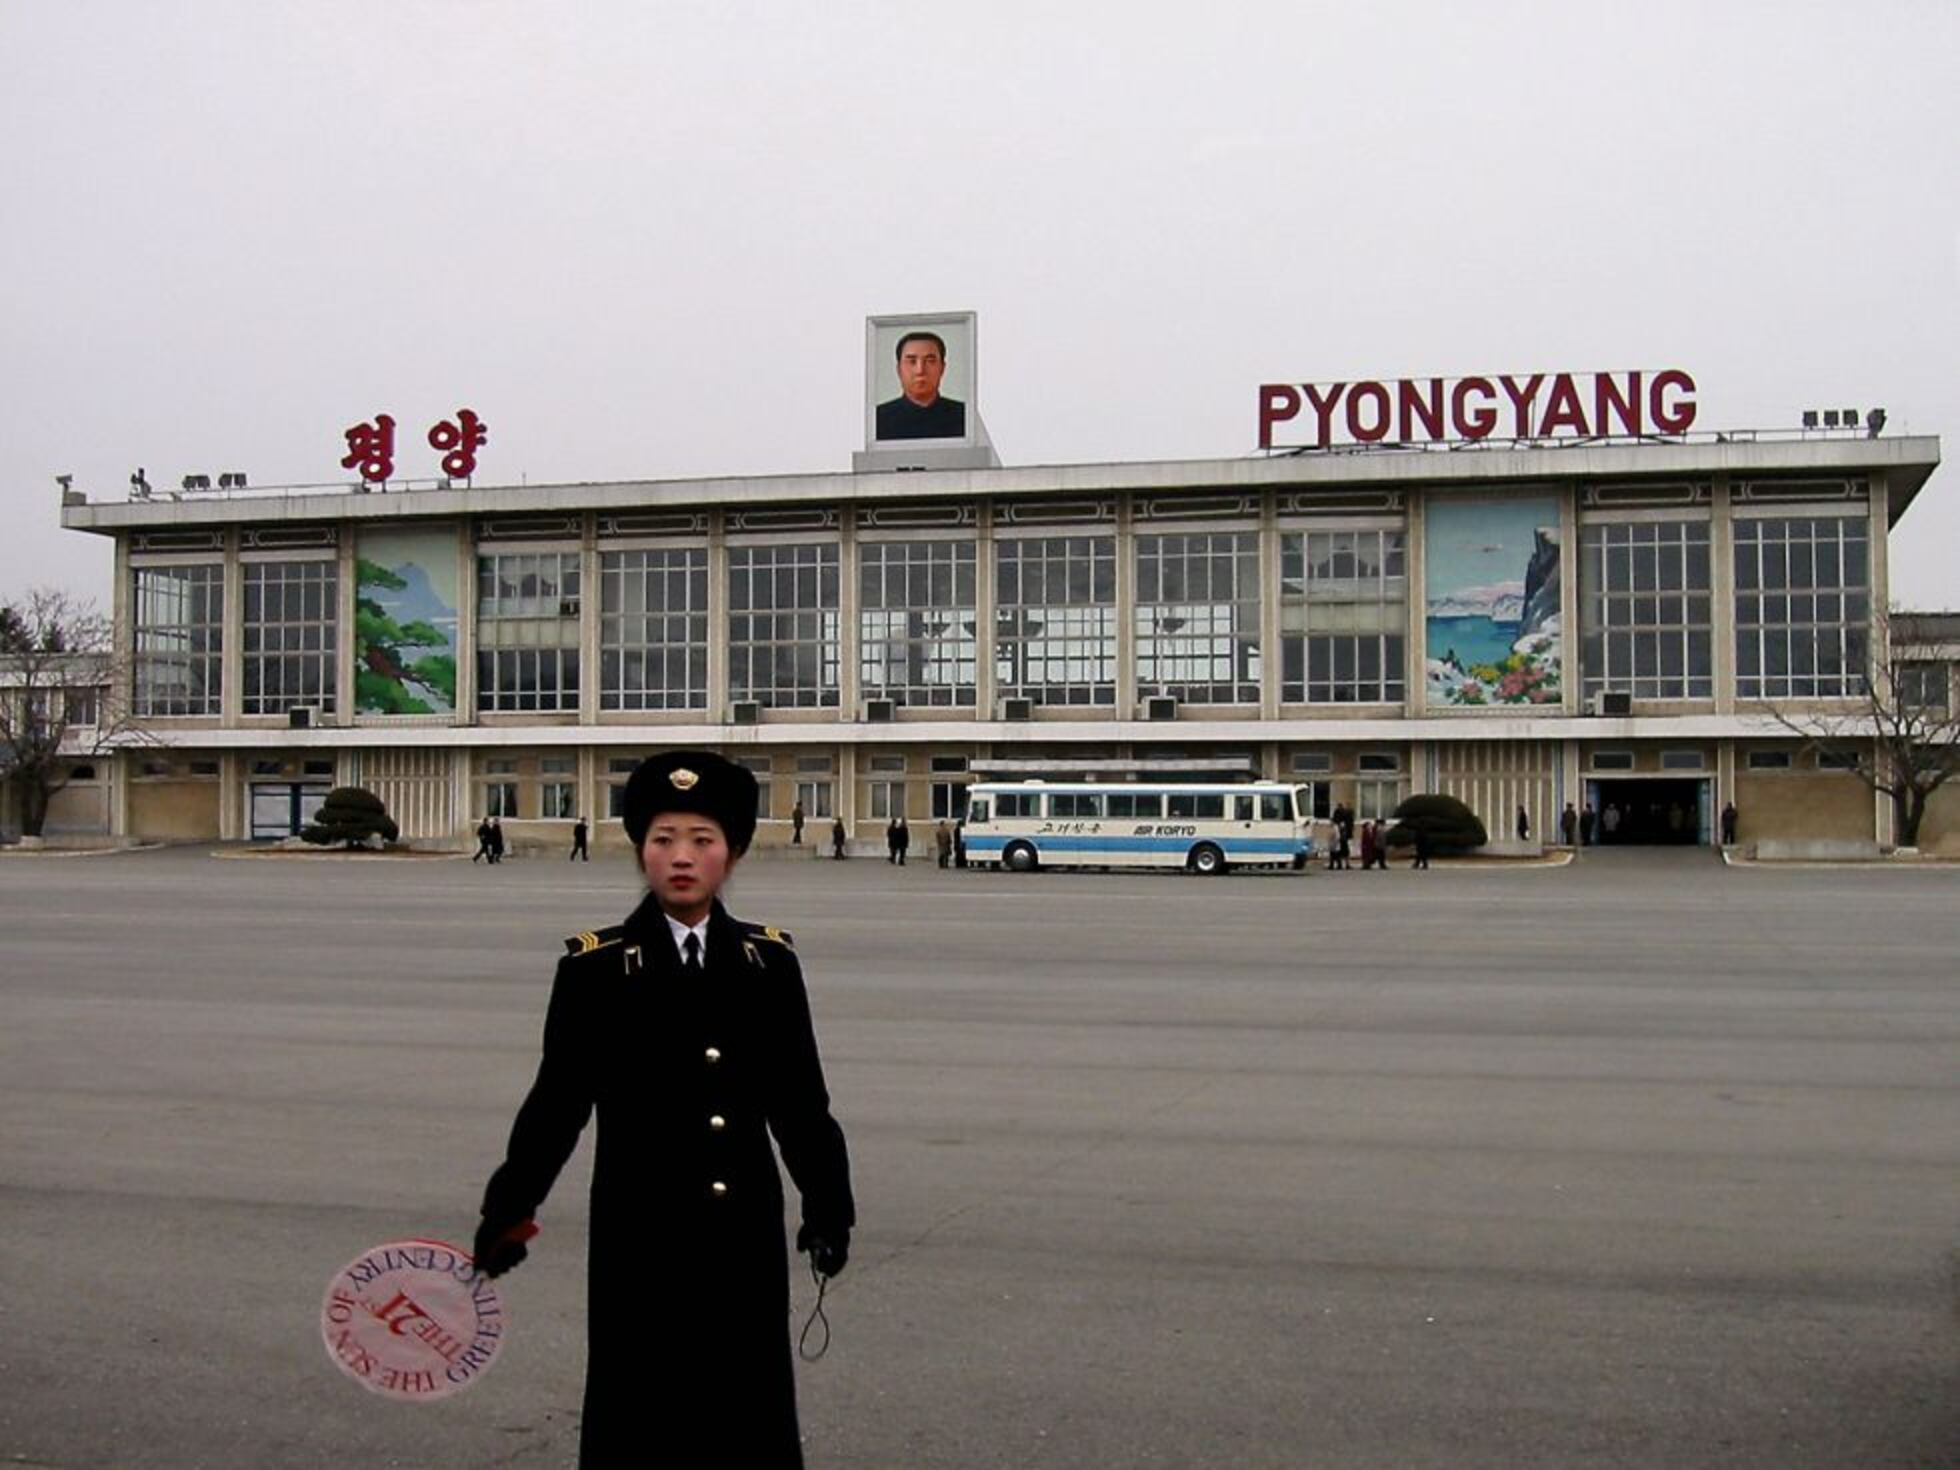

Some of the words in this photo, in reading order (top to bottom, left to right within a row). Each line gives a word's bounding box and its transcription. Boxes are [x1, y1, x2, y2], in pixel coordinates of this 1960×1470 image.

[1259, 370, 1696, 449] PYONGYANG
[341, 409, 487, 482] 평양
[1156, 826, 1196, 835] KORYO
[329, 1289, 354, 1323] OF
[412, 1323, 463, 1364] THE
[380, 1367, 435, 1392] THE
